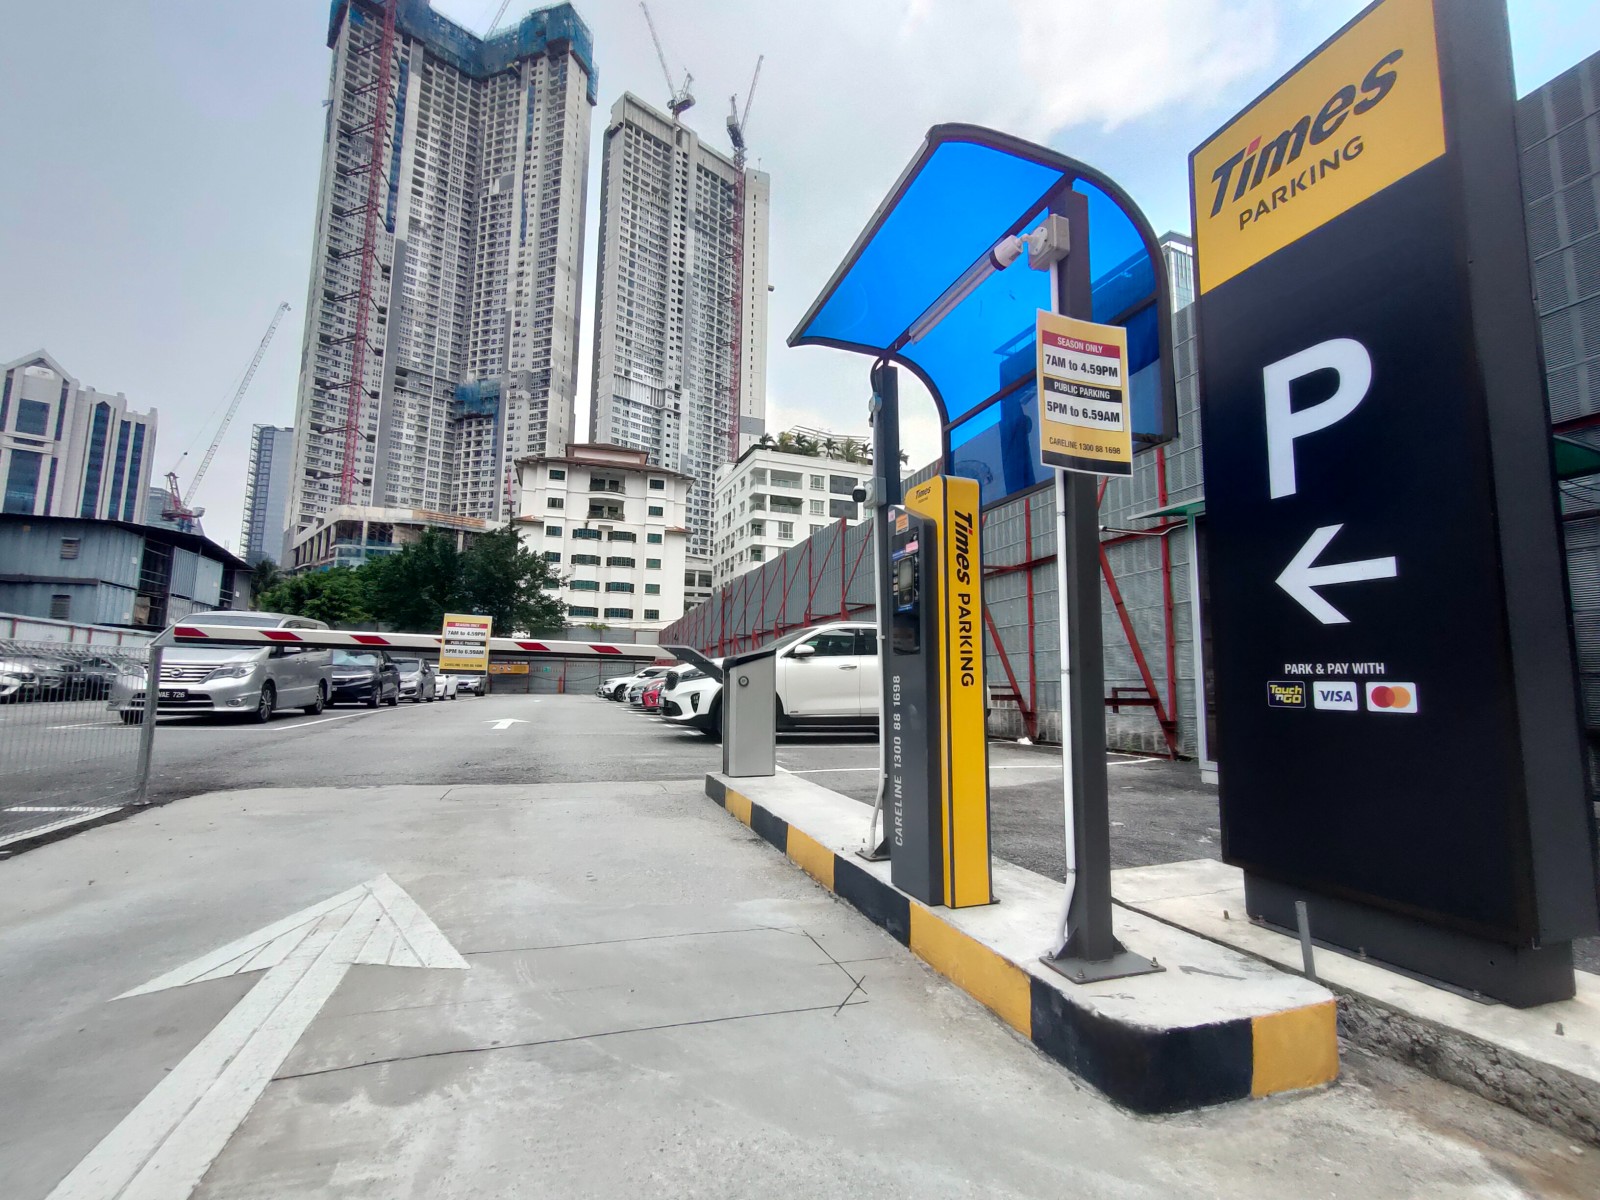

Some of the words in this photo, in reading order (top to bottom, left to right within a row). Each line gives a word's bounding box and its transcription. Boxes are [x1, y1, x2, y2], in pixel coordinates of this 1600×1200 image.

[1210, 49, 1404, 219] Times
[1239, 135, 1364, 231] PARKING
[1057, 337, 1084, 351] SEASON
[1085, 343, 1103, 354] ONLY
[1045, 354, 1066, 368] 7AM
[1069, 360, 1078, 371] to
[1081, 363, 1118, 378] 4.59PM
[1054, 382, 1078, 395] PUBLIC
[1079, 386, 1110, 399] PARKING
[1047, 401, 1067, 415] 5PM
[1070, 407, 1079, 417] to
[1082, 409, 1120, 422] 6.59AM
[1263, 338, 1372, 499] P
[1049, 437, 1077, 450] CARELINE
[1079, 443, 1094, 451] 1300
[1095, 445, 1104, 453] 88
[1105, 446, 1121, 454] 1698
[954, 510, 973, 585] Times
[957, 593, 974, 687] PARKING
[1284, 663, 1313, 674] PARK
[1315, 663, 1325, 674] &
[1327, 663, 1349, 674] PAY
[1352, 662, 1385, 674] WITH
[892, 675, 901, 706] 1698
[1270, 685, 1303, 695] Touch
[1319, 690, 1353, 702] VISA
[893, 713, 901, 731] 88
[893, 736, 902, 768] 1300
[895, 775, 903, 847] CARELINE
